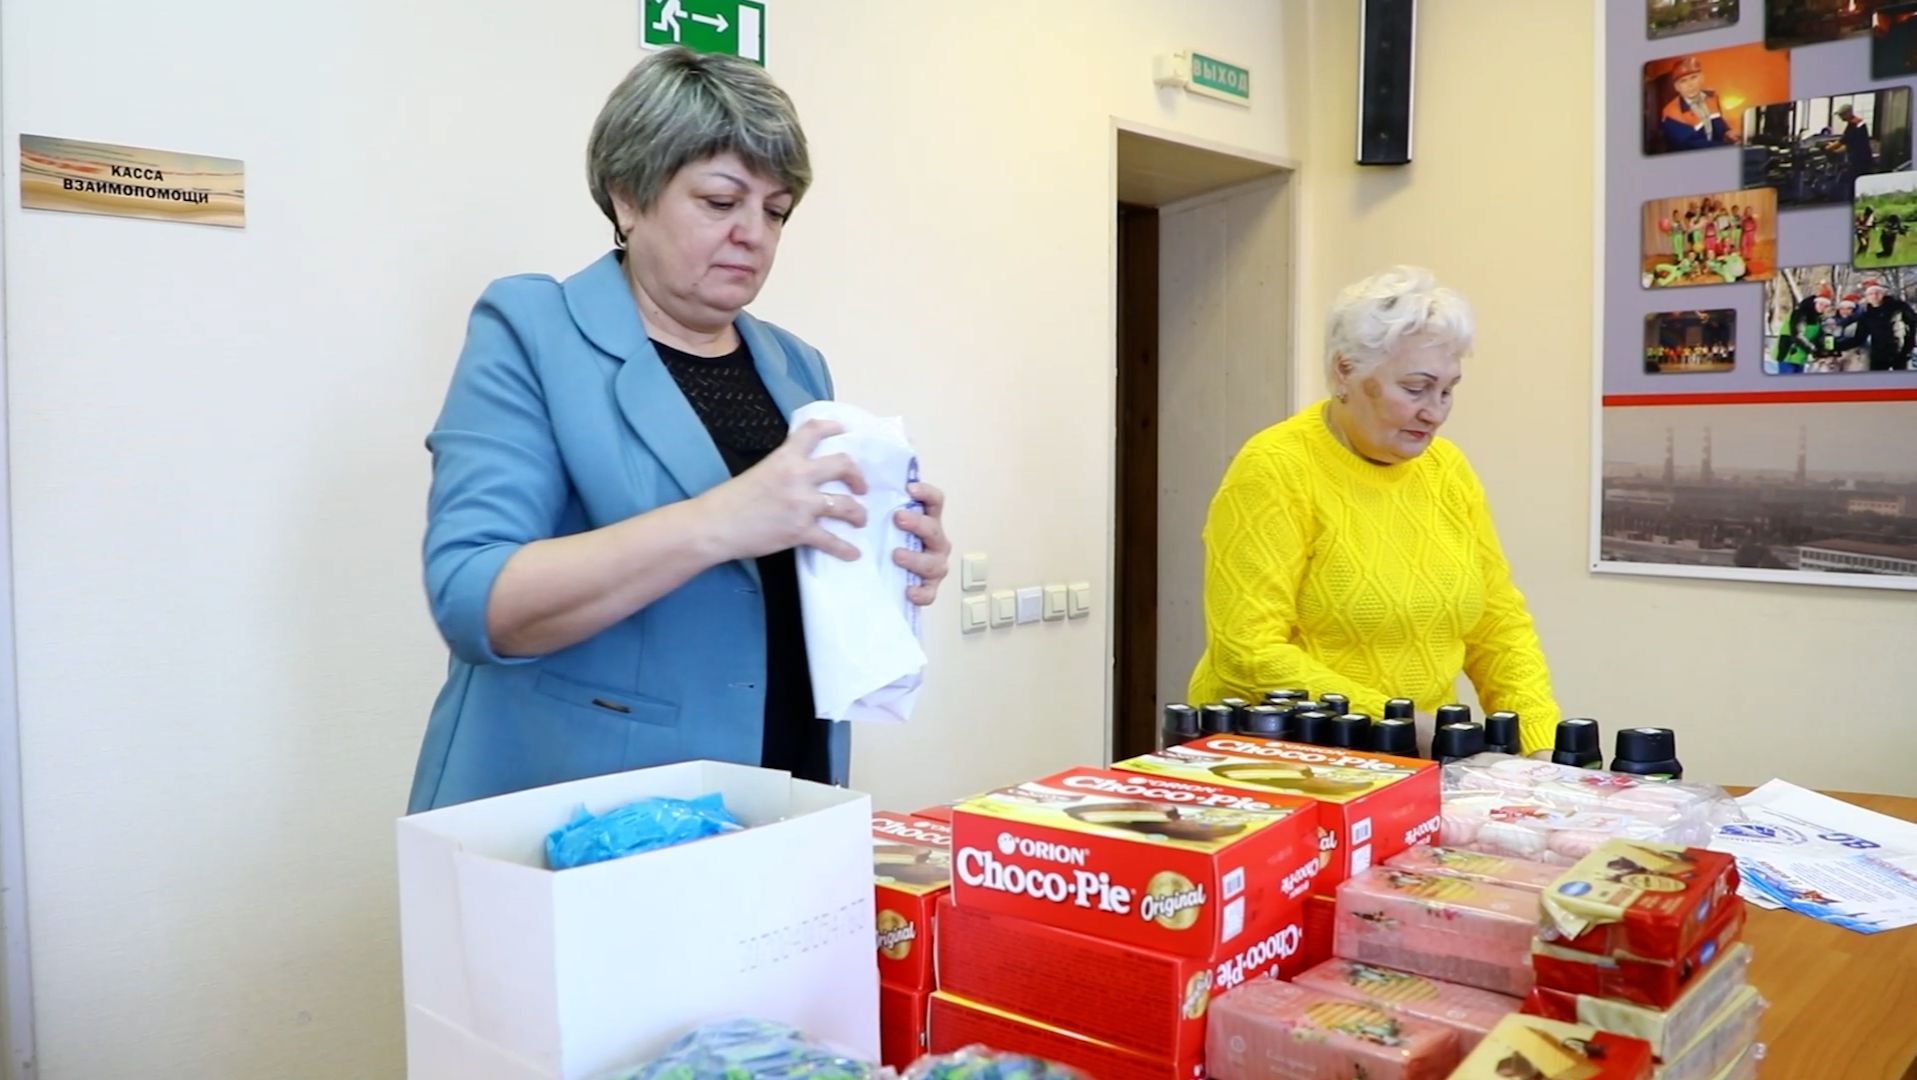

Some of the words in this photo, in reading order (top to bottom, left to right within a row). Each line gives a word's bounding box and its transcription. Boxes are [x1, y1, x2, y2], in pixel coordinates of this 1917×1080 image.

[1193, 59, 1247, 92] ВЫХОД
[111, 165, 164, 181] КАССА
[63, 178, 209, 204] ВЗАИМОПОМОЩИ
[1019, 838, 1085, 866] ORION
[1141, 883, 1206, 921] Original
